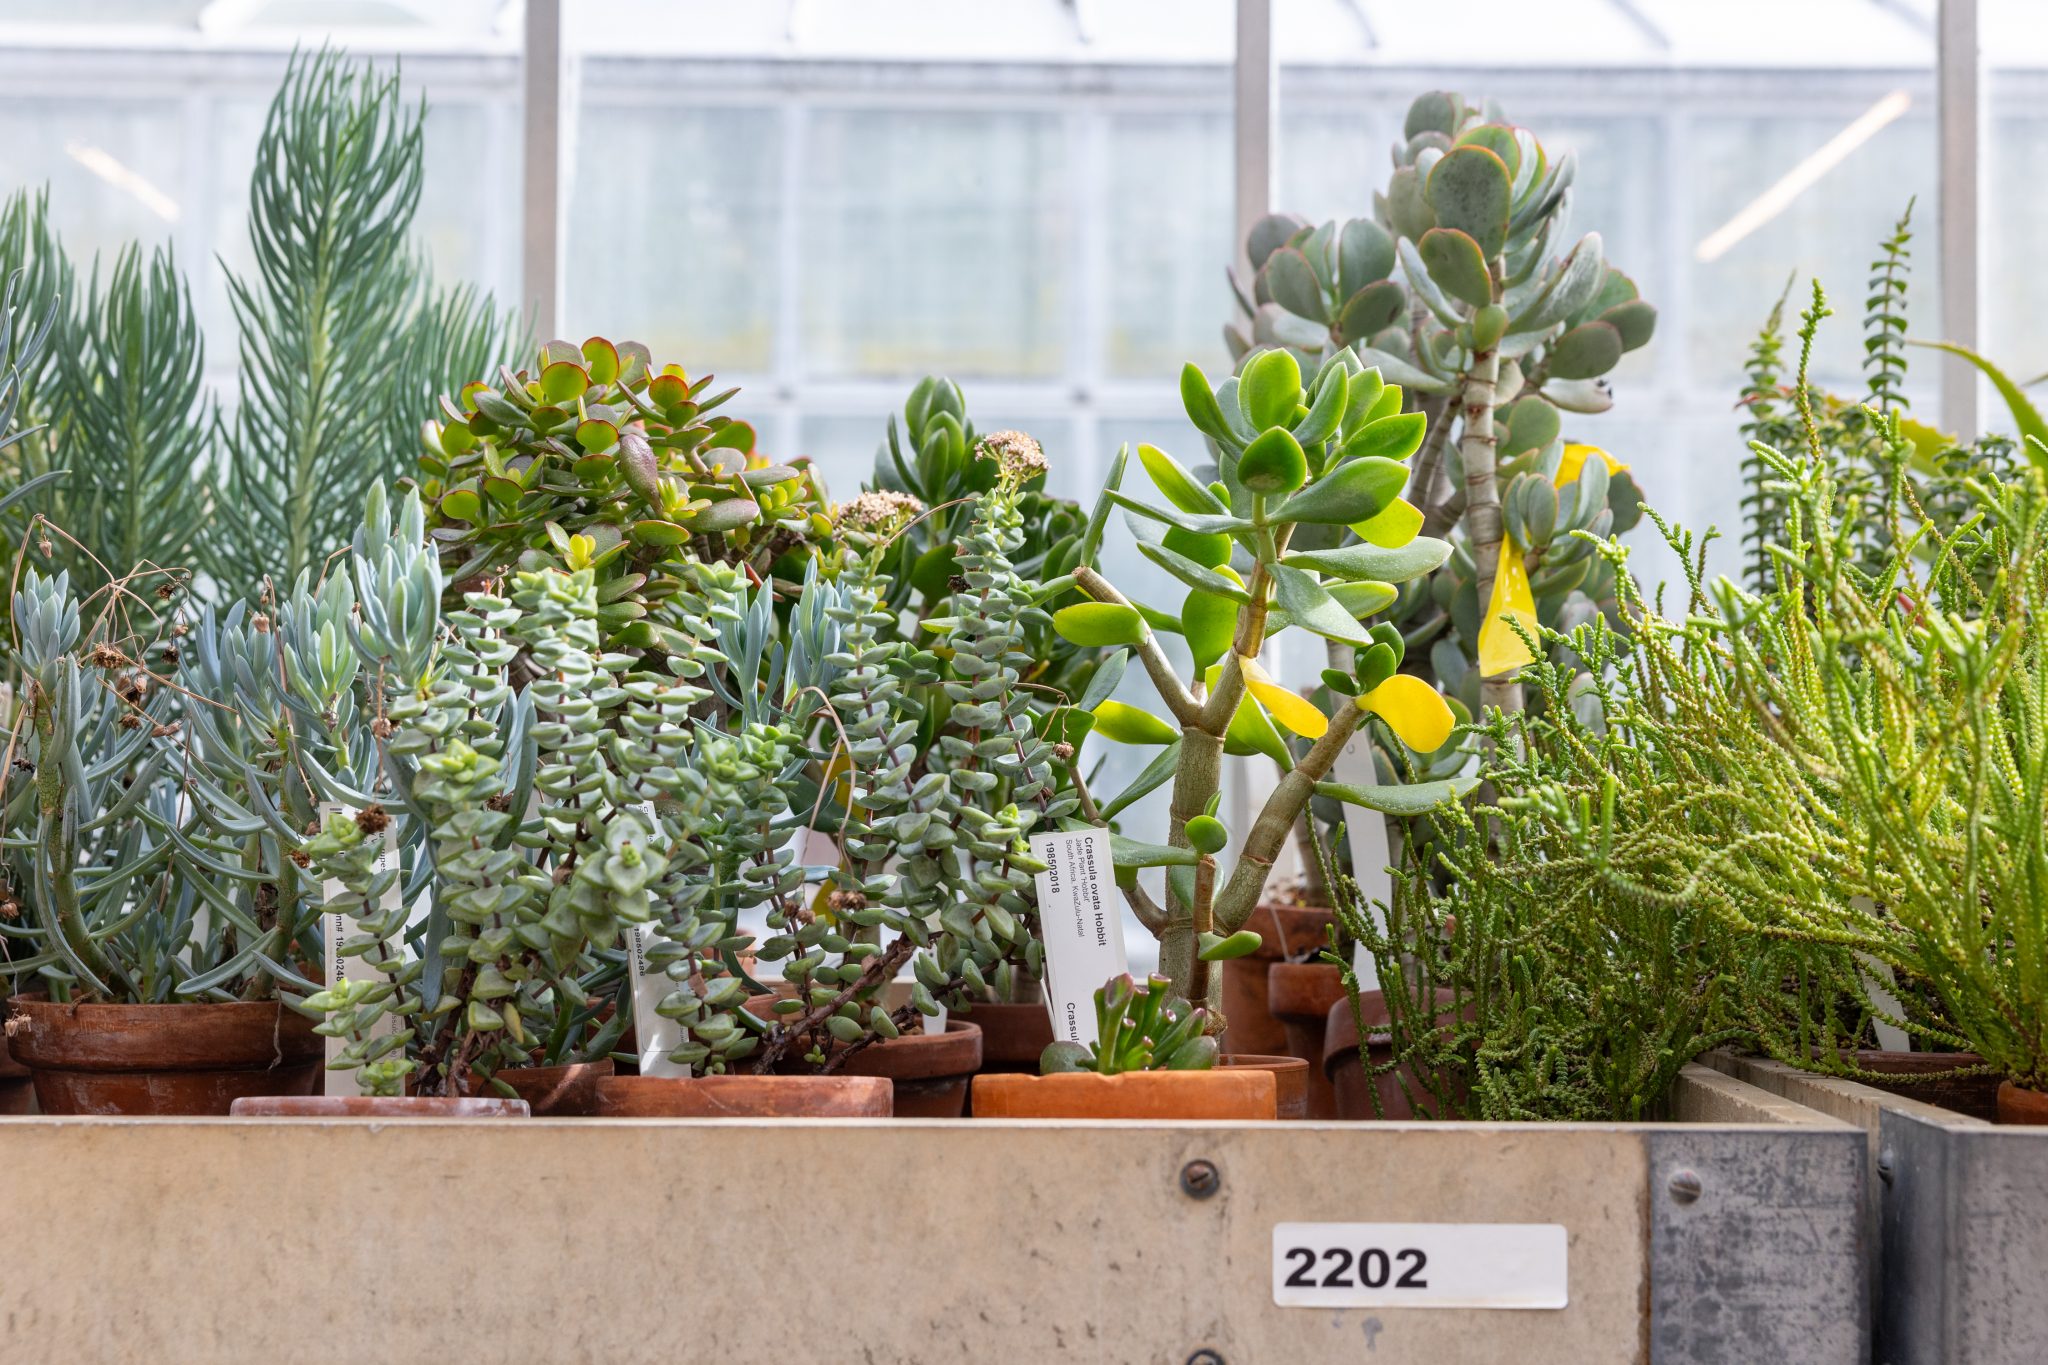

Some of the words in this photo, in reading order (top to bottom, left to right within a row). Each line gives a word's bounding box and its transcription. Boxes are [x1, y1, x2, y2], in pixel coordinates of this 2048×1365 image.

[1046, 841, 1060, 894] 198502018
[1075, 838, 1083, 856] Jade
[1078, 857, 1086, 875] Plant
[1084, 836, 1097, 881] Crassula
[1066, 839, 1074, 860] South
[1072, 885, 1085, 938] KwaZulu-Natal
[1090, 883, 1101, 911] ovata
[1095, 912, 1106, 947] Hobbit
[1067, 1002, 1080, 1044] Crassul
[1284, 1247, 1428, 1289] 2202
